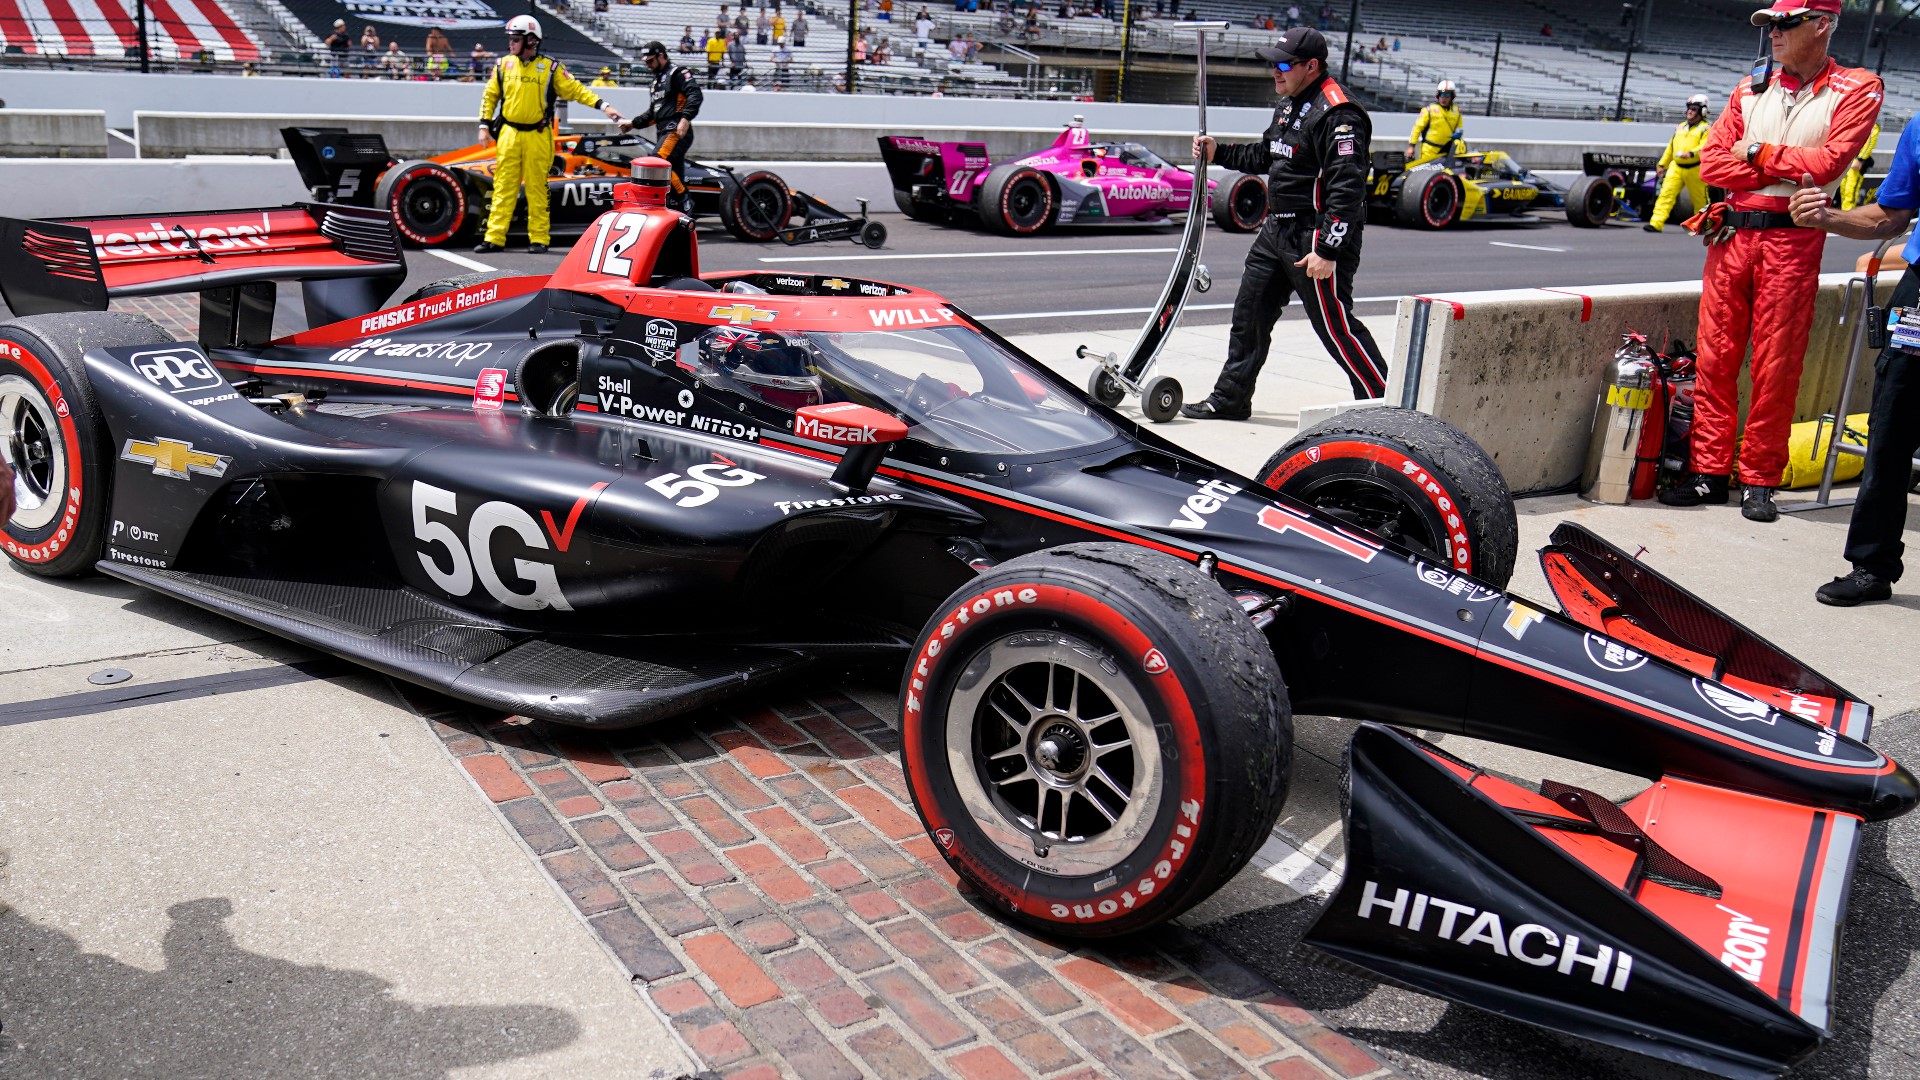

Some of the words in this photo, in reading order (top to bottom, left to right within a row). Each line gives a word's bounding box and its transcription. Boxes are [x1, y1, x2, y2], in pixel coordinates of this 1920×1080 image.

[1071, 128, 1087, 145] 27
[336, 169, 361, 197] 5
[950, 171, 976, 194] 27
[587, 212, 647, 278] 12
[776, 277, 805, 287] verizon
[860, 283, 887, 297] verizon
[361, 308, 415, 333] PENSKE
[418, 299, 452, 318] Truck
[455, 284, 498, 309] Rental
[869, 309, 938, 327] WILL
[645, 336, 676, 348] INDYCAR
[139, 355, 213, 389] PPG
[598, 375, 631, 395] Shell
[598, 392, 686, 426] V-Power
[796, 415, 878, 443] Mazak
[645, 462, 767, 508] 5G
[773, 492, 904, 516] Firestone
[7, 486, 82, 561] Firestone
[142, 530, 159, 542] NTT
[110, 547, 167, 568] Firestone
[412, 479, 575, 611] 5G
[906, 586, 1038, 713] Firestone
[1050, 798, 1201, 920] Firestone
[1357, 880, 1633, 993] HITACHI
